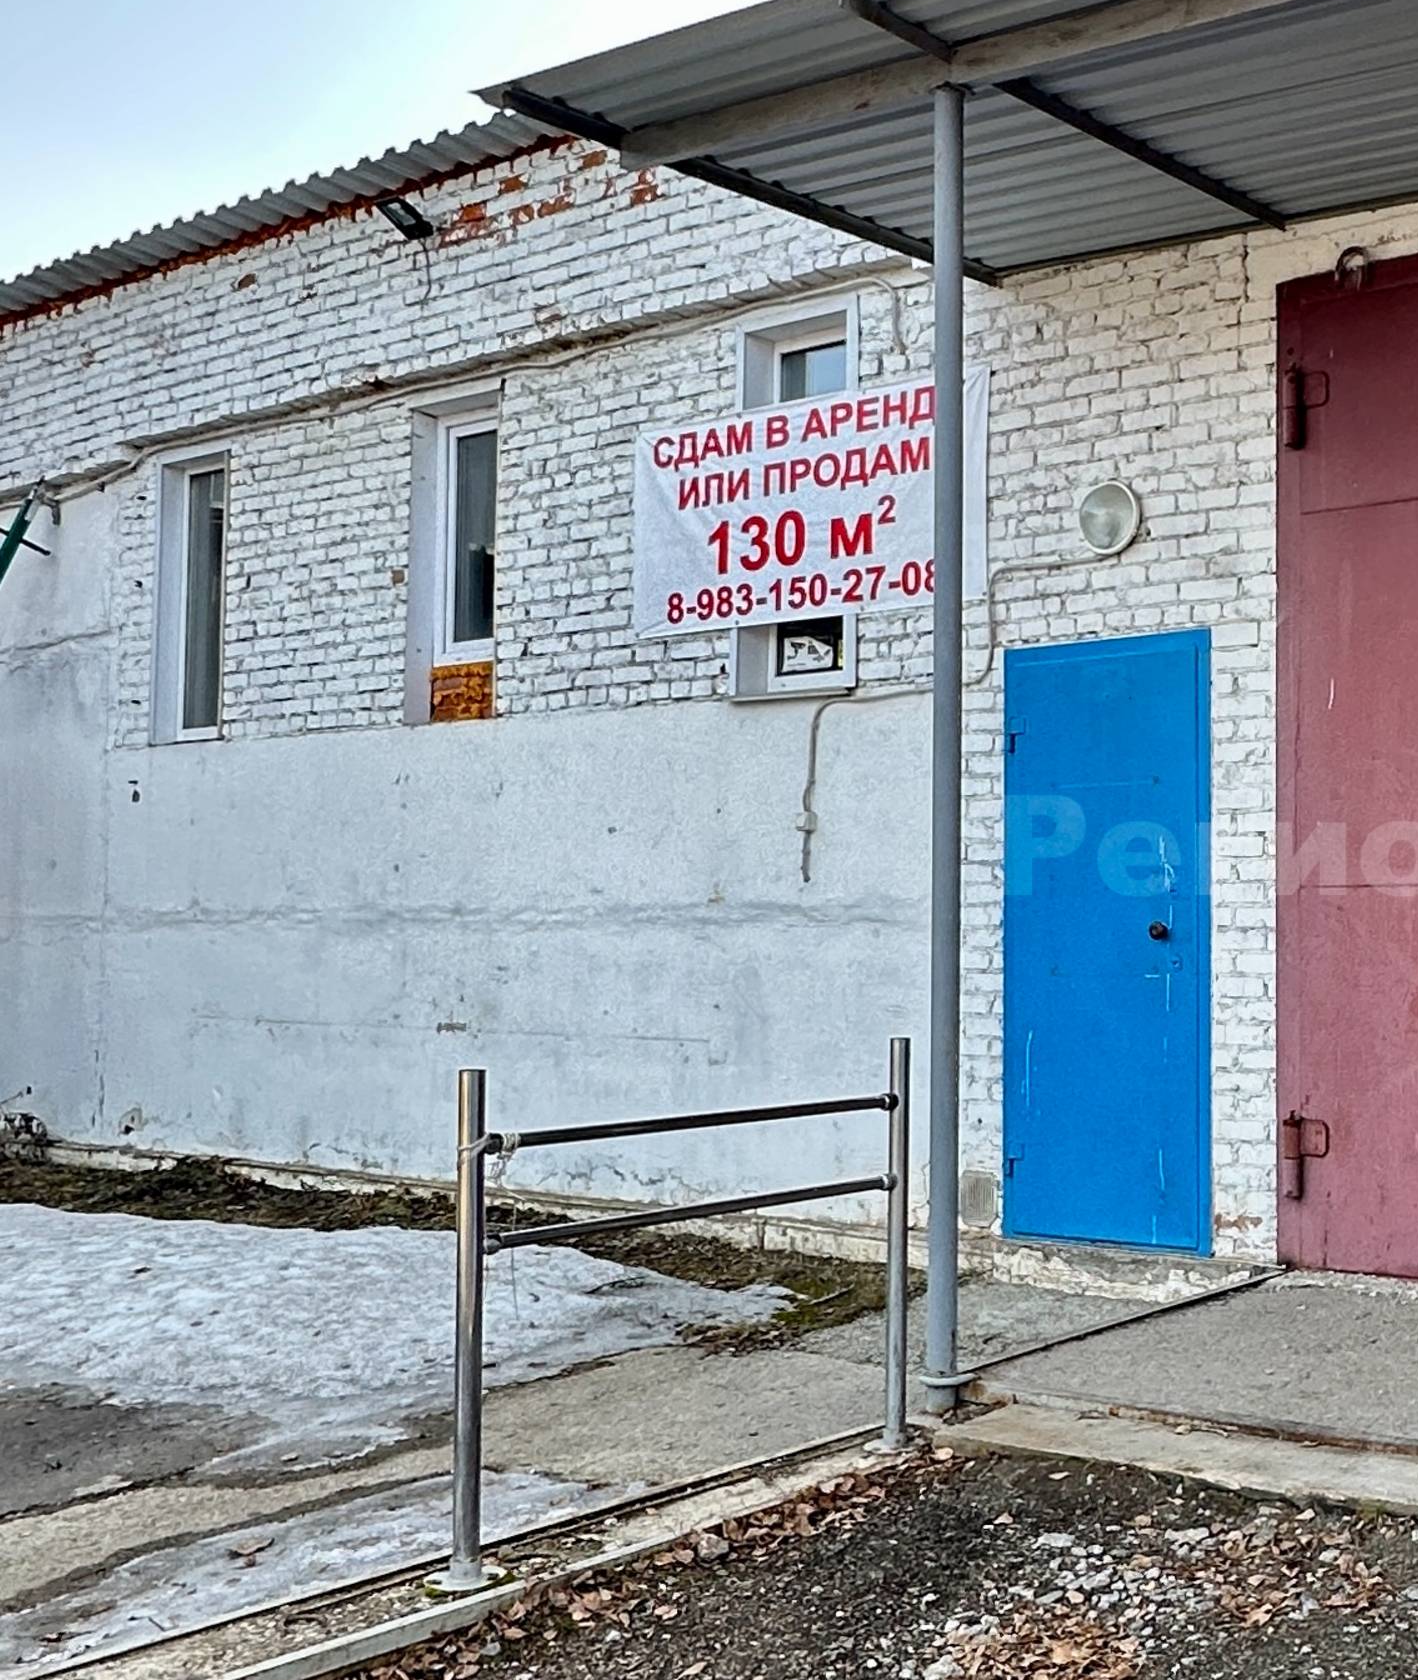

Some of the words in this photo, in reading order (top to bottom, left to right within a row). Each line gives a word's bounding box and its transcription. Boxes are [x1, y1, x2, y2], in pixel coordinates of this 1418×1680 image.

[653, 421, 753, 470] СДАМ
[766, 415, 790, 448] В
[801, 385, 935, 442] АРЕНД
[678, 469, 749, 509] ИЛИ
[763, 437, 930, 496] ПРОДАМ
[707, 510, 806, 574] 130
